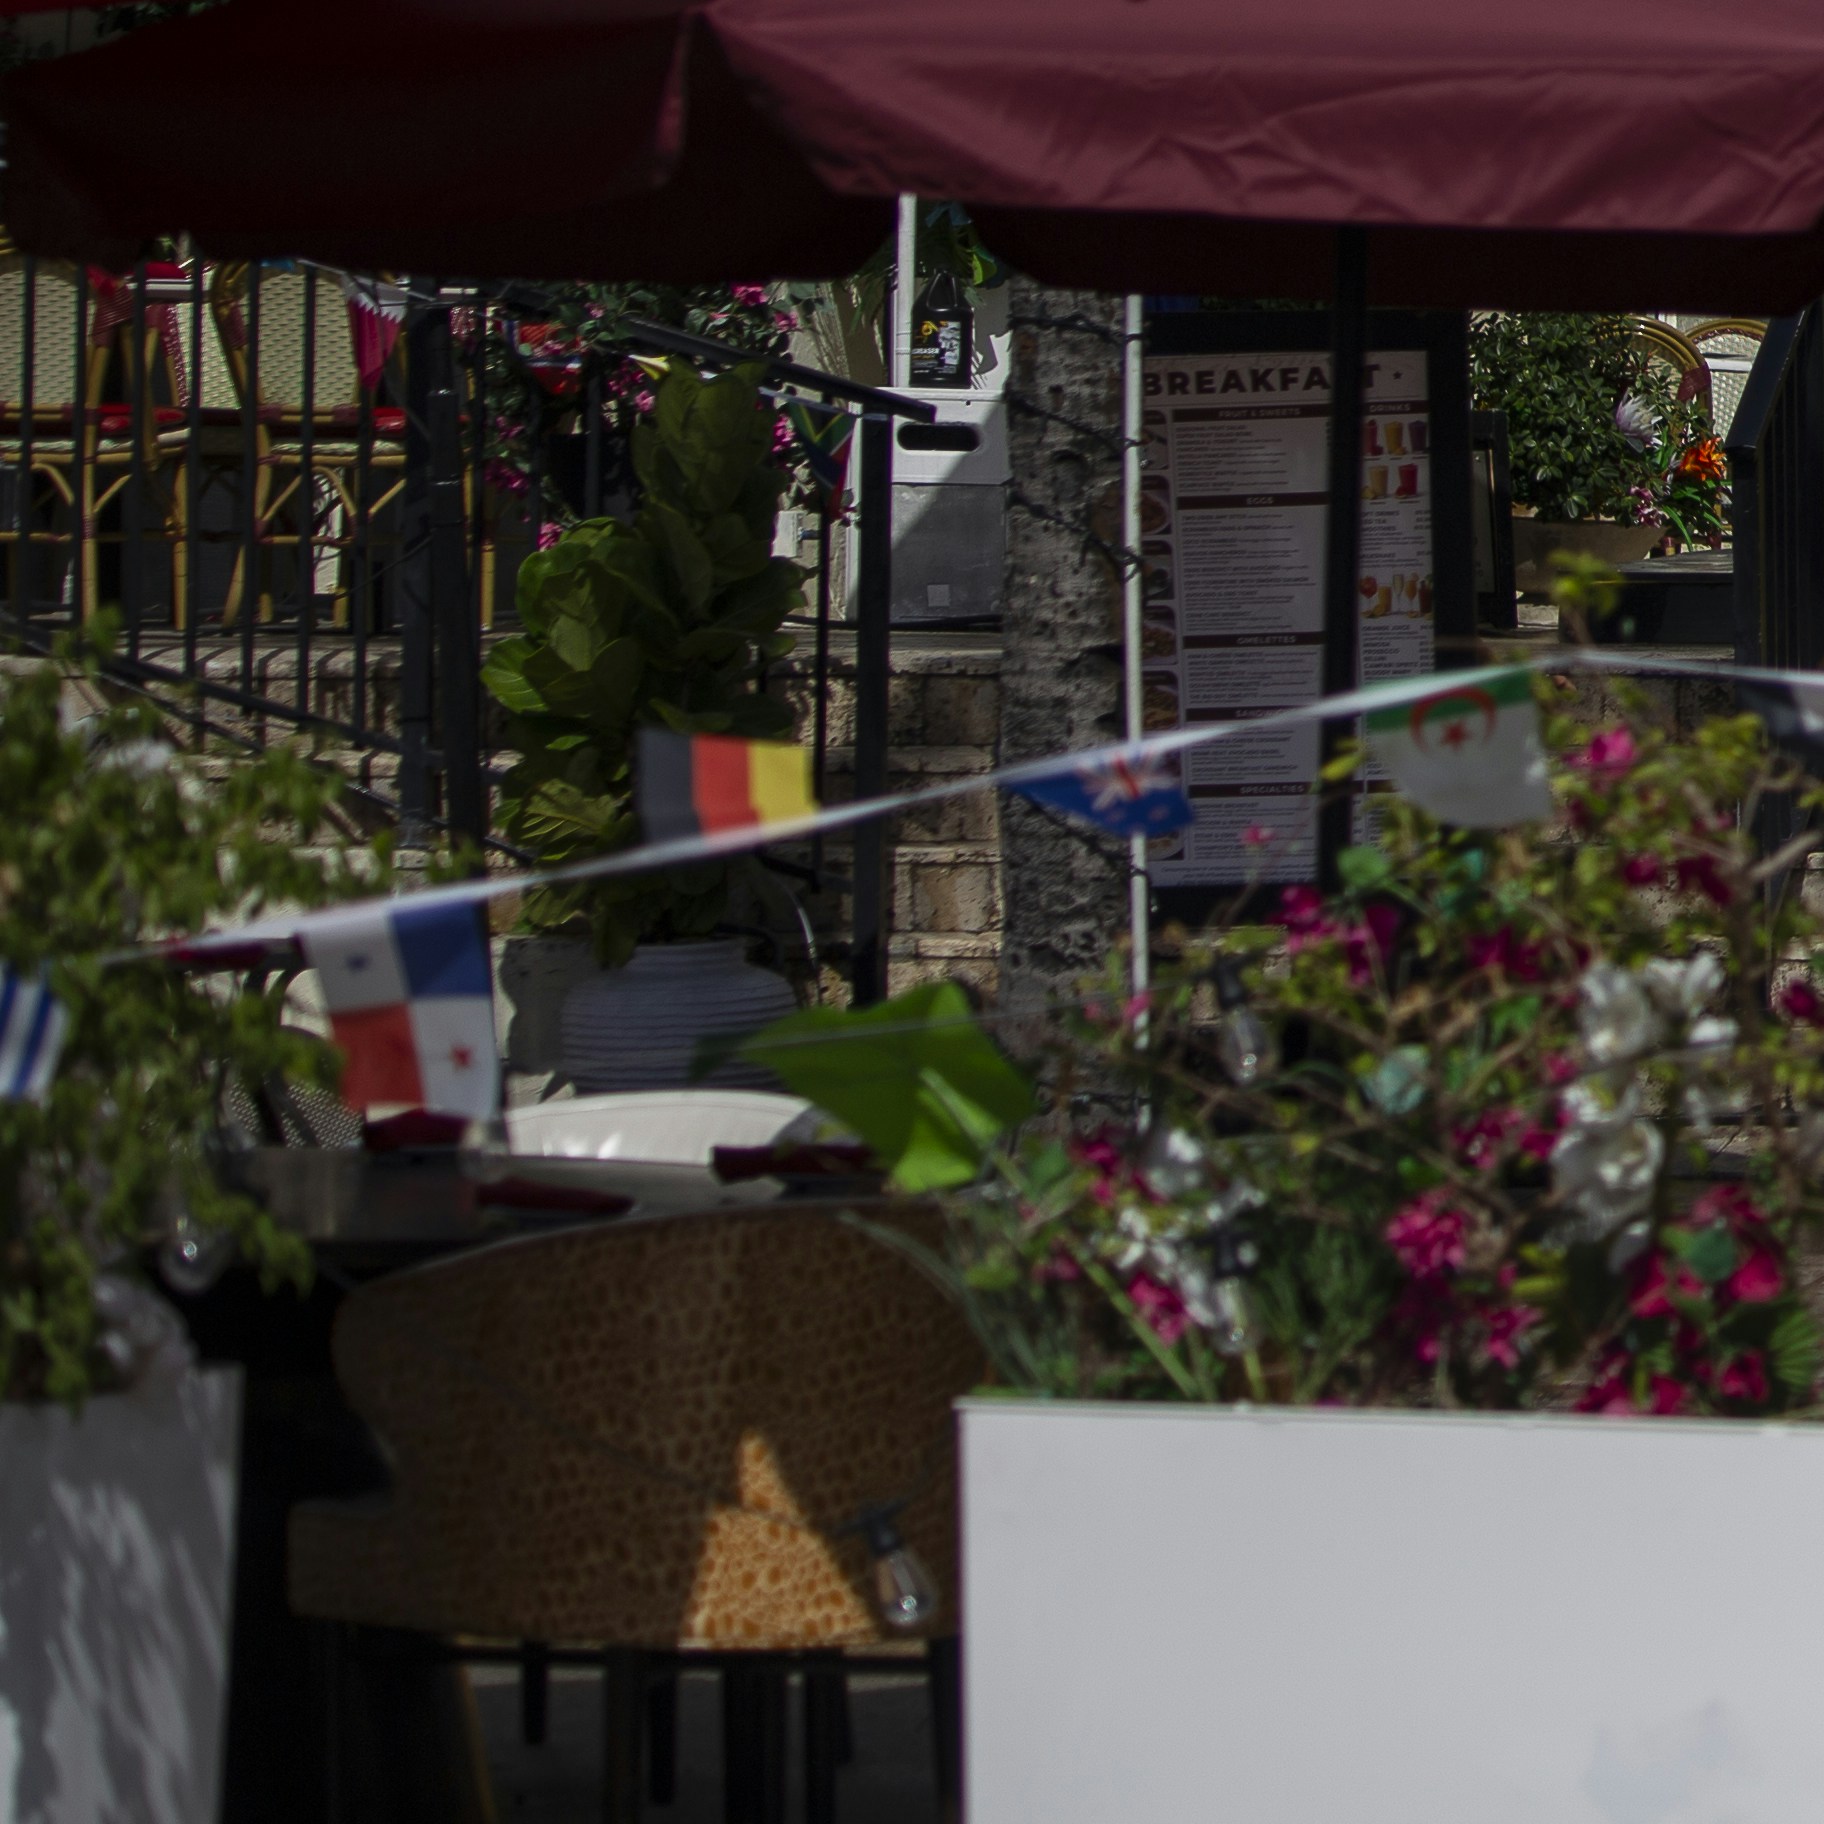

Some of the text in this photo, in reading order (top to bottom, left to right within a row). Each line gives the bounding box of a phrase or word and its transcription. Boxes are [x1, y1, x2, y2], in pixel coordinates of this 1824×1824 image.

[1143, 363, 1380, 396] BREAKFAT
[1369, 403, 1411, 413] DRINKS
[1246, 496, 1274, 506] EGGS
[1236, 635, 1296, 645] OMELETTES
[1240, 784, 1305, 795] SPECIALTIES
